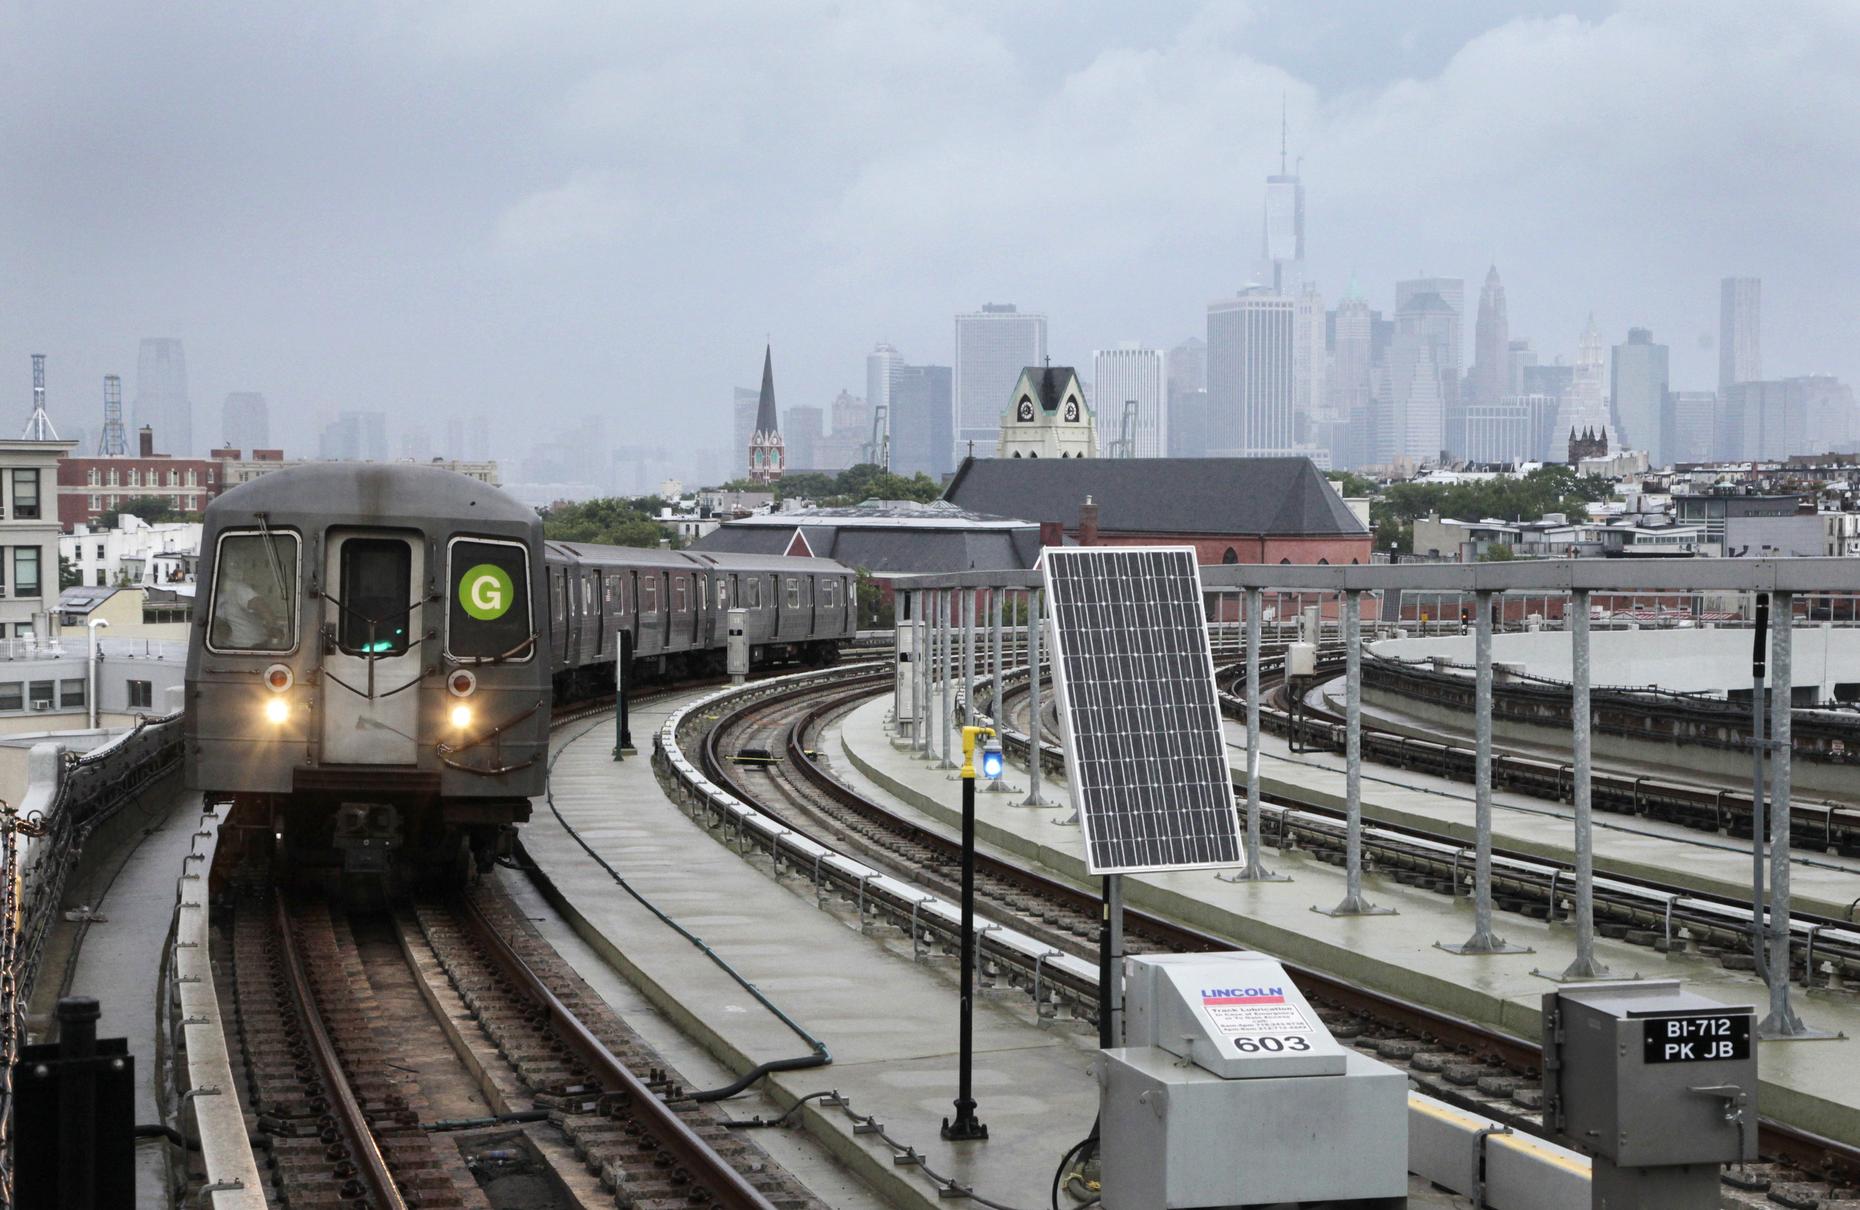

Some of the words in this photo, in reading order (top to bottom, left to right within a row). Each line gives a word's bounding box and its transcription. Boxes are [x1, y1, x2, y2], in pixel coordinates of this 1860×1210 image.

[472, 575, 501, 610] G
[1201, 987, 1283, 997] LINCOLN
[1234, 1036, 1311, 1053] 603
[1665, 1042, 1695, 1060] PK
[1703, 1041, 1734, 1058] JB
